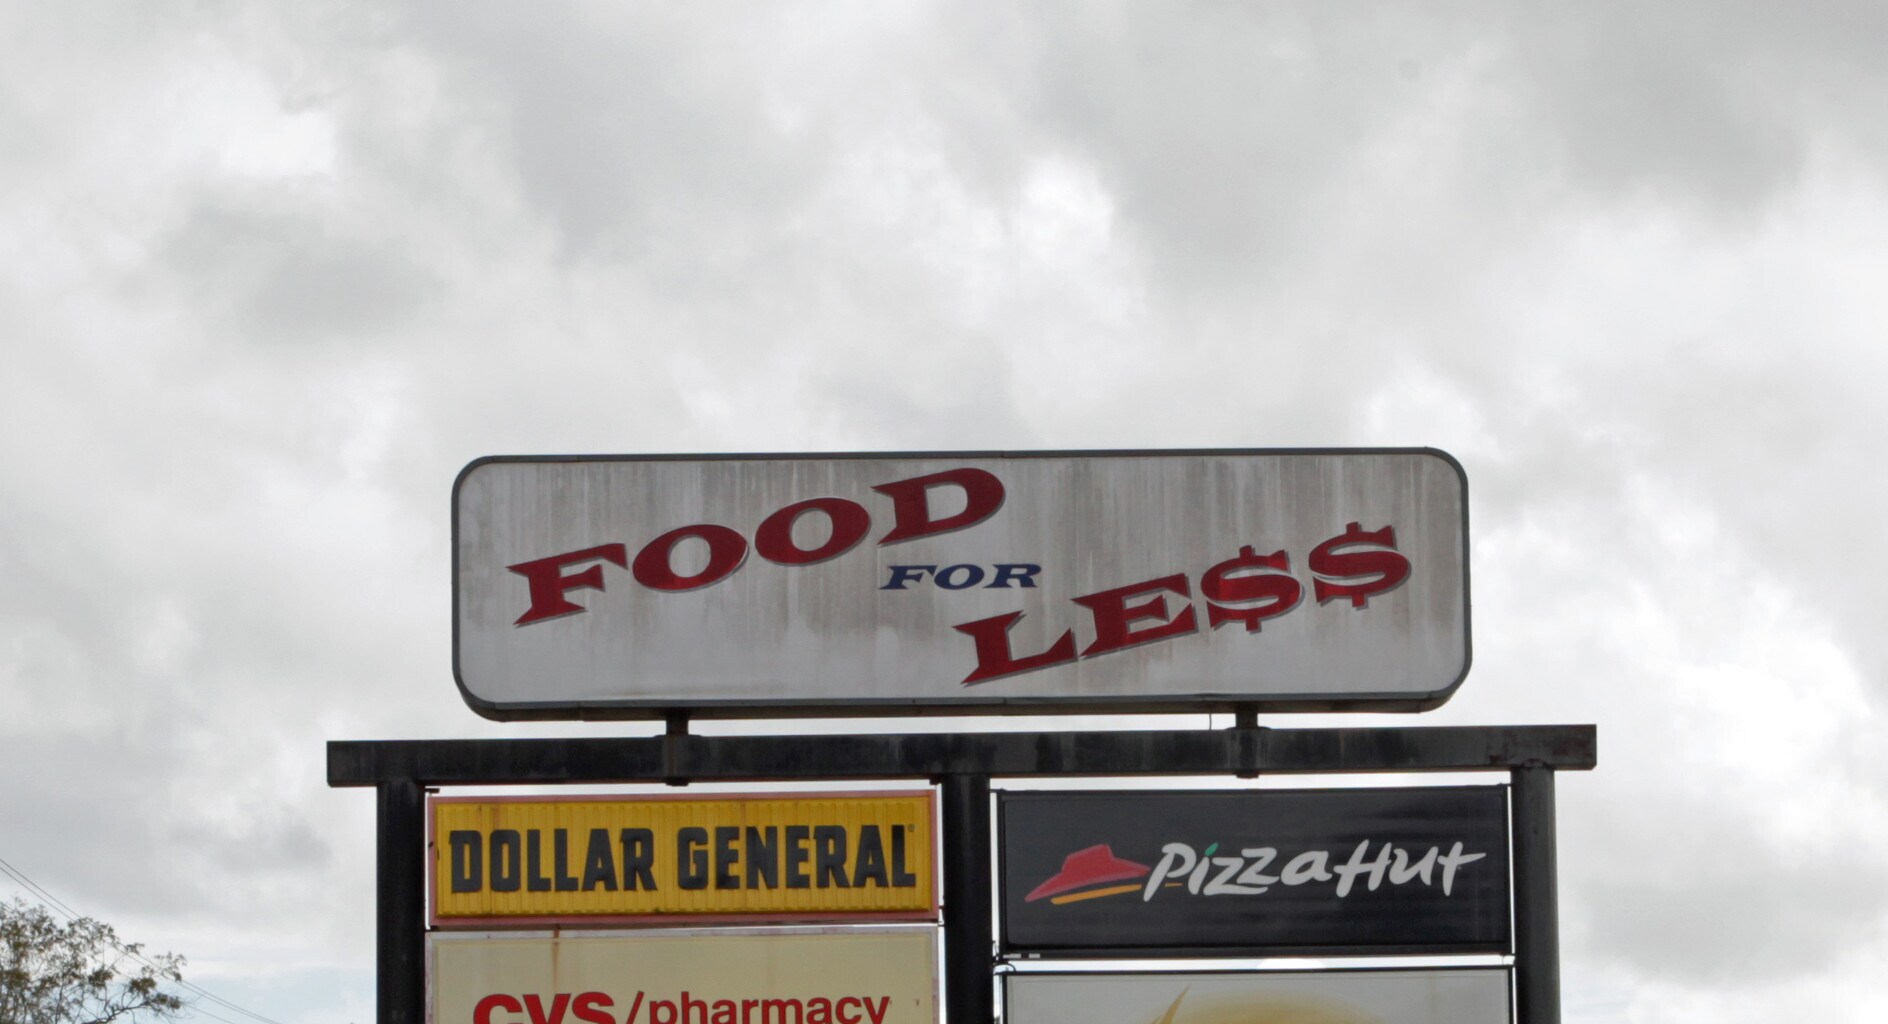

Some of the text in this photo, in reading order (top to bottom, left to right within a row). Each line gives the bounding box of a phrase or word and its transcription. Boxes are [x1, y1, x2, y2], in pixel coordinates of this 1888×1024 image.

[507, 467, 1006, 627] FOOD
[880, 563, 1043, 590] FOR
[449, 827, 658, 893] DOLLAR
